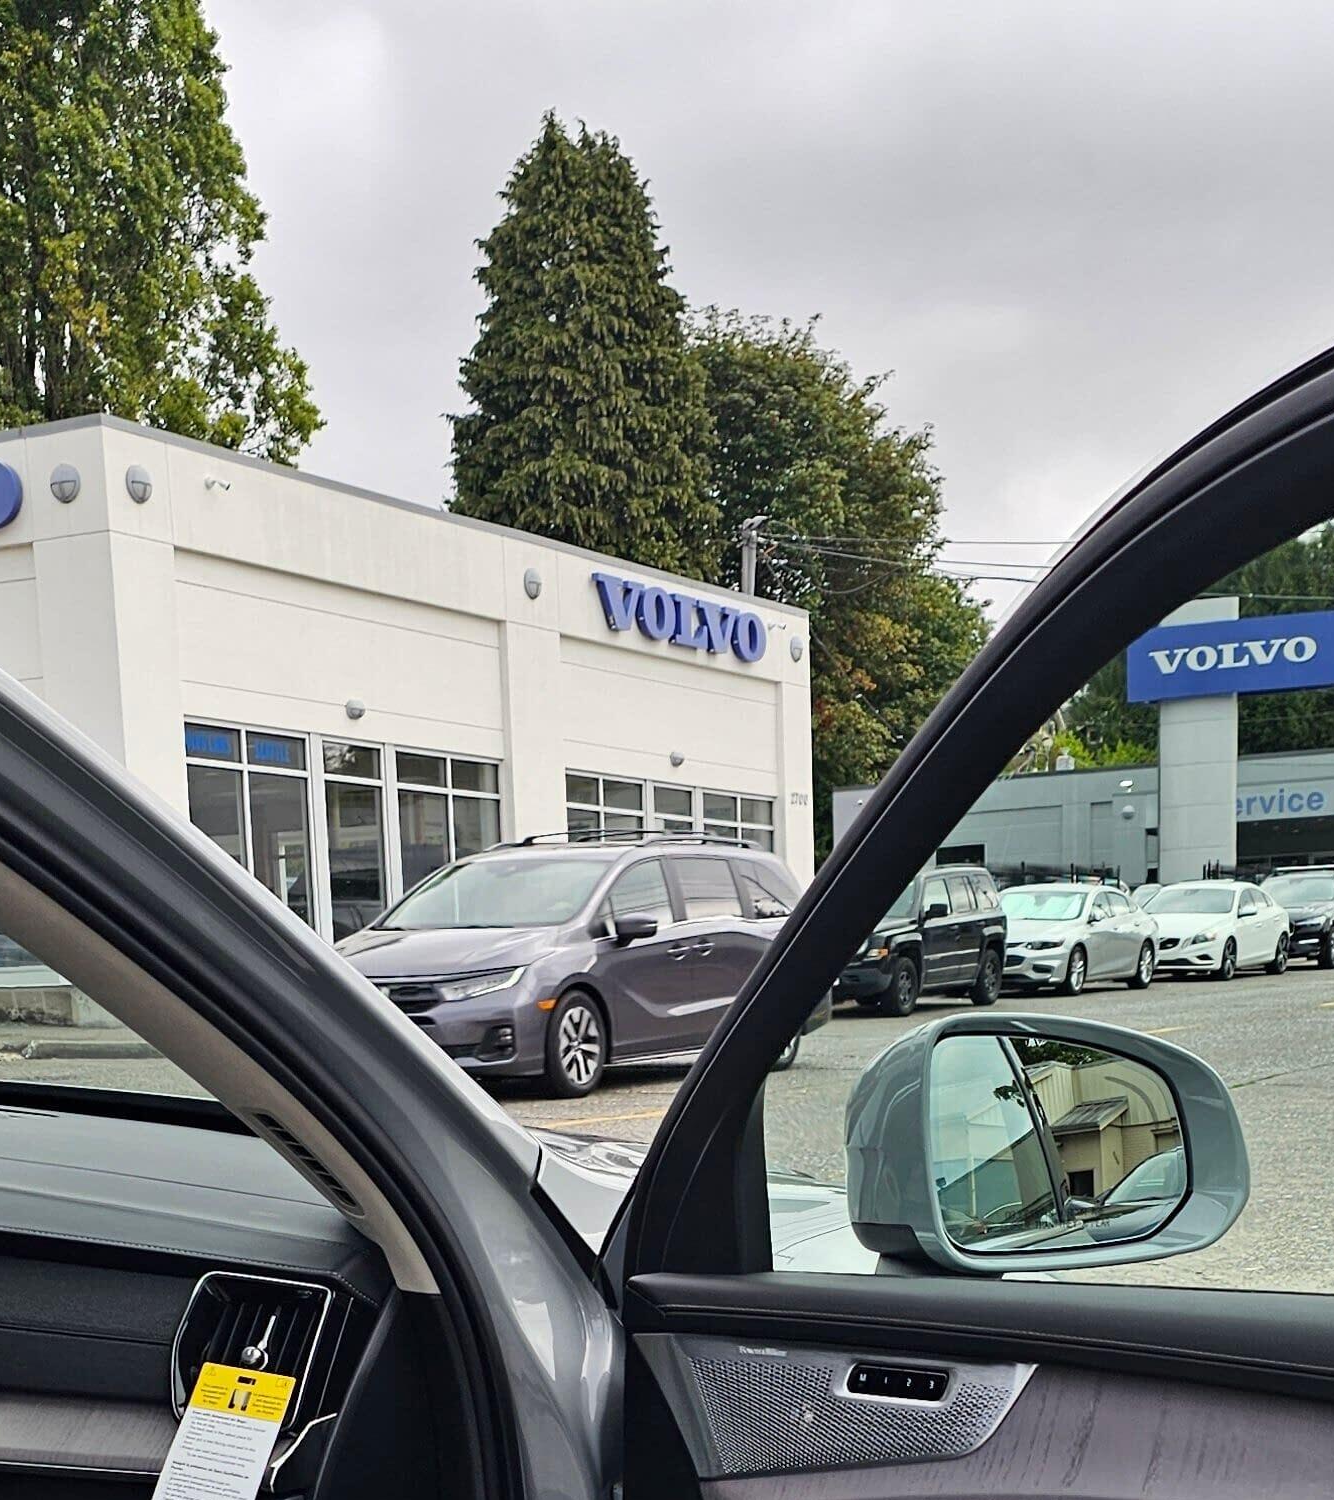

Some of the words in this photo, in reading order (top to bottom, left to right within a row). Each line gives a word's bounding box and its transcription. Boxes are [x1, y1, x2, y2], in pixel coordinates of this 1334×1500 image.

[592, 573, 767, 663] VOLVO
[1148, 635, 1318, 675] VOLVO
[1235, 787, 1325, 817] ervice
